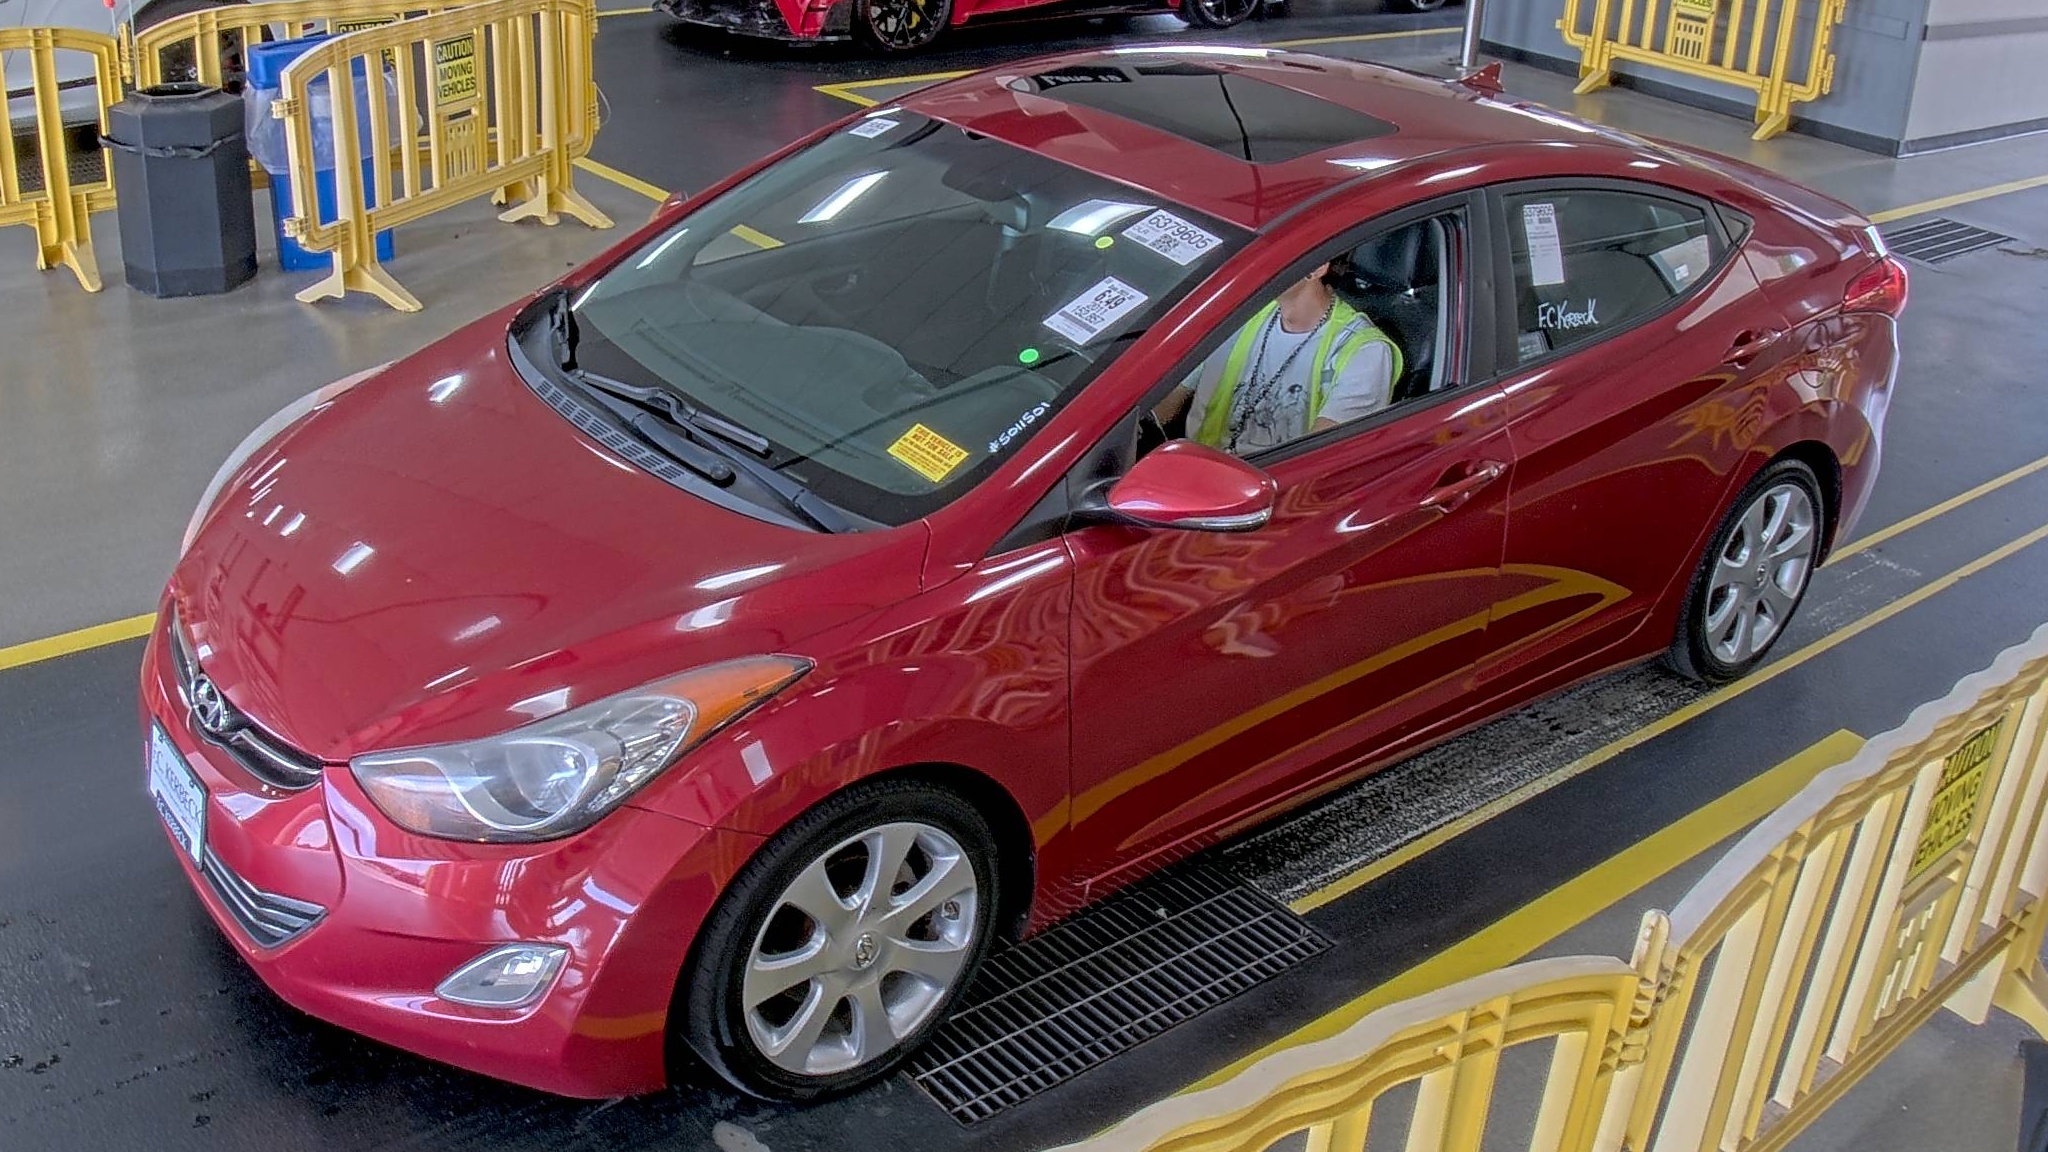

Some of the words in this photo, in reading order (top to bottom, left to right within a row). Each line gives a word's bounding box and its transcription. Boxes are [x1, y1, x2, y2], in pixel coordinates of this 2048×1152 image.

[436, 38, 473, 63] CAUTION
[440, 61, 473, 80] MOVING
[438, 78, 476, 99] VEHICLES
[1149, 214, 1212, 249] 6379605
[1095, 289, 1127, 310] 6:49
